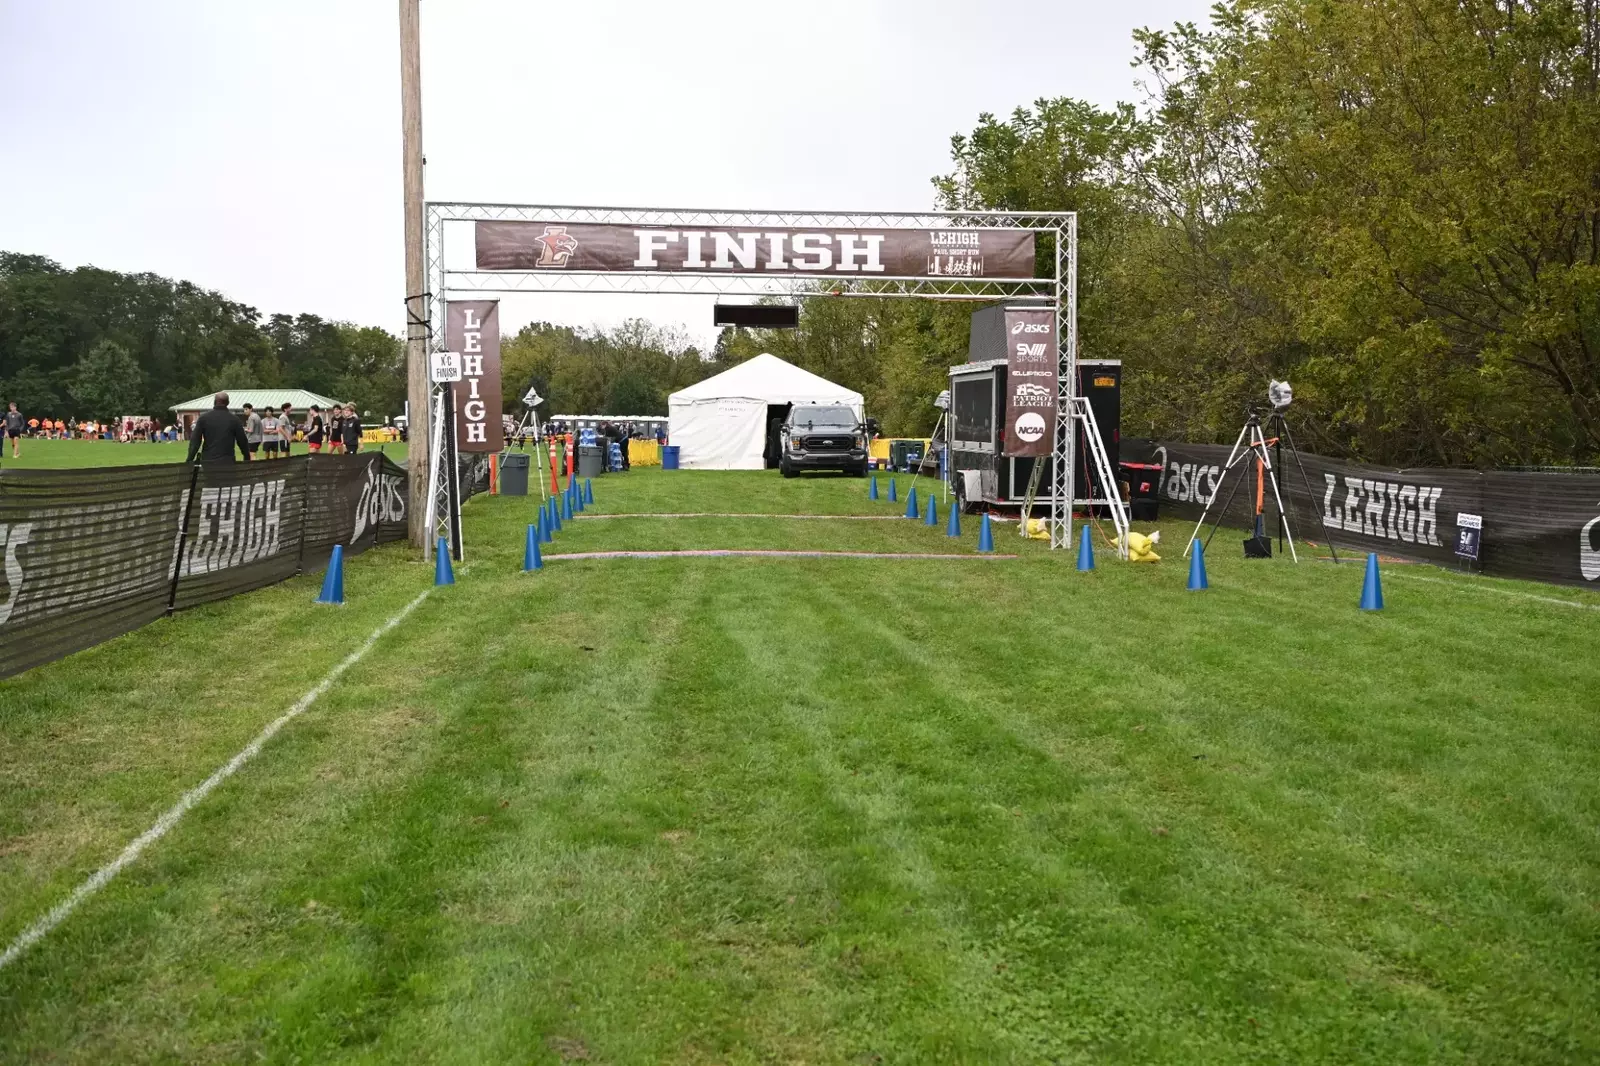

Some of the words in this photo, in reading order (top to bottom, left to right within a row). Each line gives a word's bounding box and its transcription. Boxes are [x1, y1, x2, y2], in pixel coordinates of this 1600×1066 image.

[633, 229, 886, 272] FINISH
[930, 232, 980, 245] LEHIGH
[436, 367, 458, 378] FINISH
[1016, 355, 1048, 363] SPORTS
[463, 309, 487, 443] LEHIGH
[1018, 426, 1045, 435] NCAA
[1323, 473, 1443, 547] LEHIGH
[168, 480, 286, 580] LEHIGH
